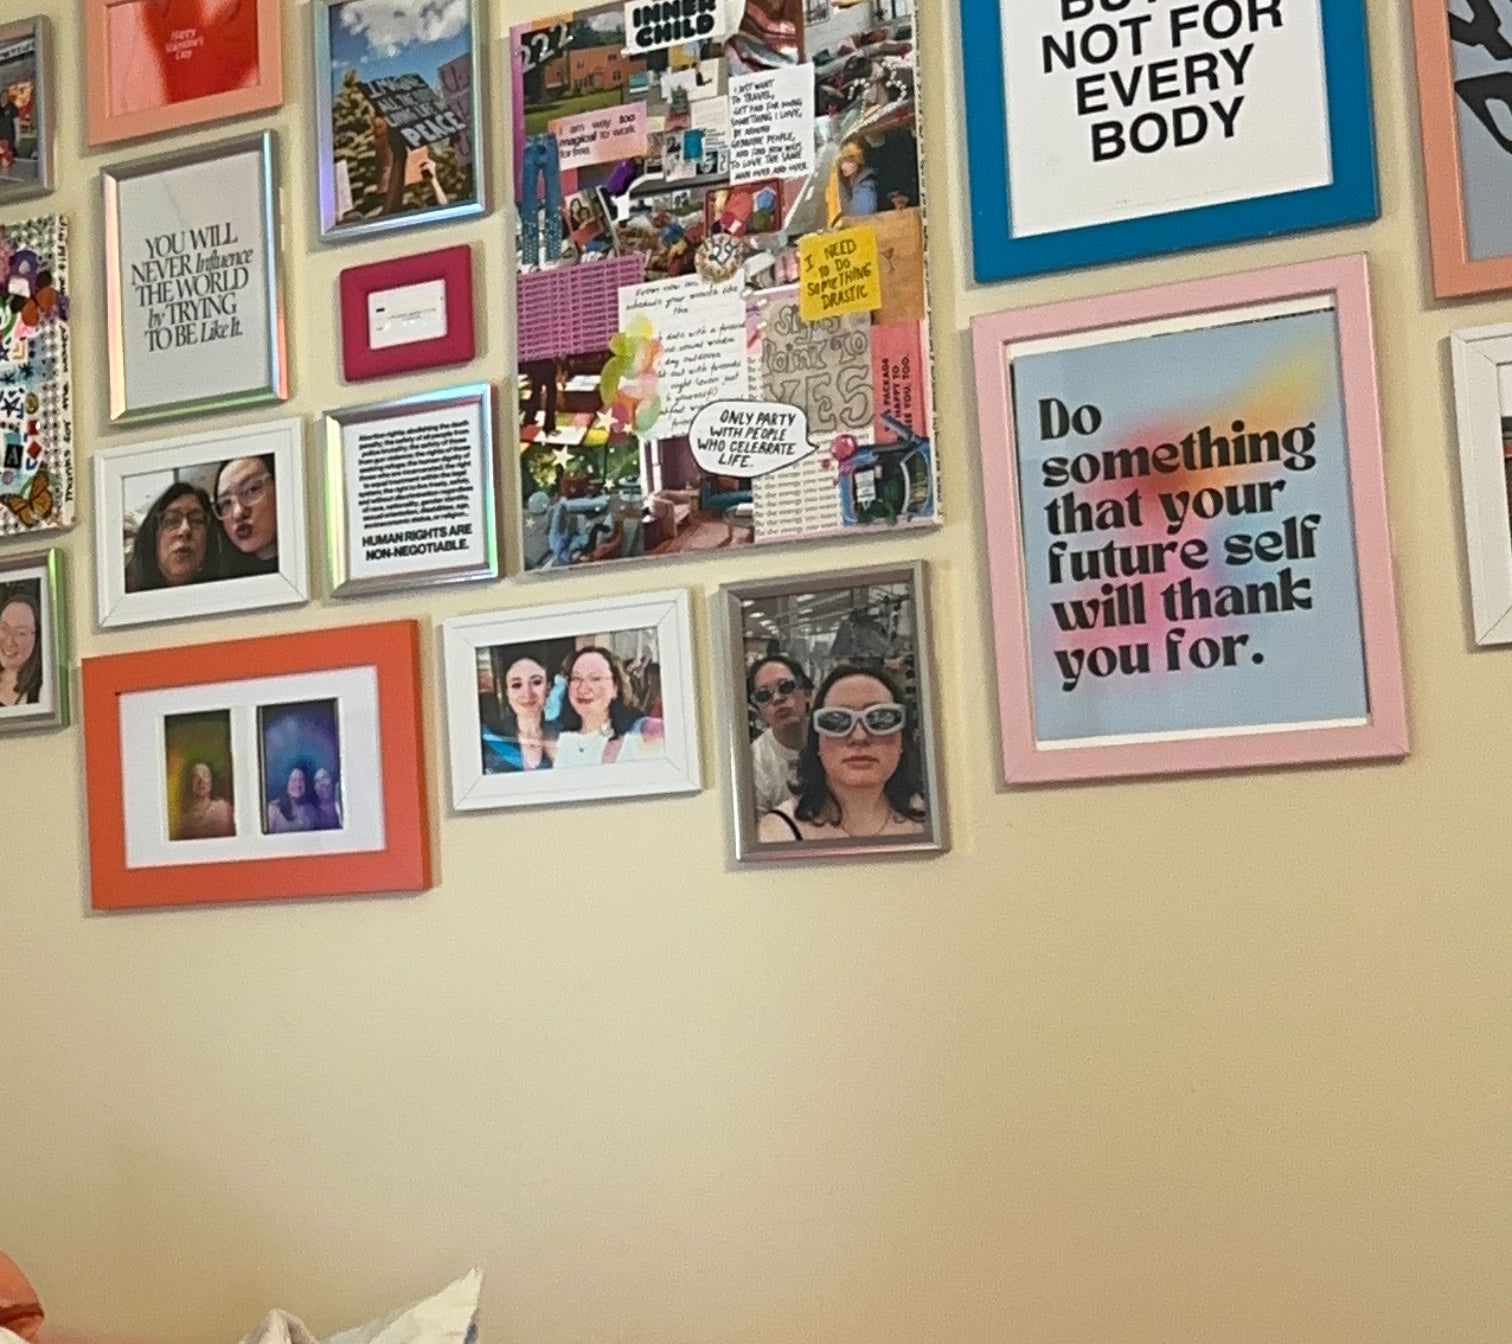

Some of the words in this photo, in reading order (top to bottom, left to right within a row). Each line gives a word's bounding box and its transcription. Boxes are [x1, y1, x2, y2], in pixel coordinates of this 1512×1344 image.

[635, 13, 715, 48] CHILD
[1041, 14, 1153, 75] NOT
[1074, 43, 1256, 117] EVERY
[400, 111, 467, 148] PEACE
[1090, 95, 1246, 163] BODY
[145, 230, 186, 259] YOU
[189, 222, 238, 250] WILL
[804, 254, 814, 273] I
[824, 239, 857, 260] NEED
[131, 254, 192, 286] NEVER
[135, 280, 174, 307] THE
[176, 266, 249, 299] WORLD
[807, 262, 872, 296] SOMETHING
[819, 266, 830, 278] TO
[835, 258, 850, 271] DO
[148, 308, 165, 329] by
[165, 292, 237, 326] TRYING
[821, 284, 869, 310] DRASTIC
[144, 327, 173, 352] TO
[175, 322, 198, 347] BE
[200, 319, 229, 343] Like
[720, 409, 753, 425] ONLY
[755, 413, 797, 426] PARTY
[762, 364, 876, 434] YES
[710, 426, 743, 437] WITH
[745, 427, 786, 441] PEOPLE
[1037, 396, 1102, 441] Do
[697, 438, 725, 451] WHO
[730, 440, 797, 455] CELEBRATE
[1041, 419, 1317, 488] something
[1043, 488, 1143, 536] that
[1157, 479, 1286, 534] your
[362, 532, 404, 547] HUMAN
[405, 526, 448, 542] RIGHTS
[449, 523, 473, 537] ARE
[1046, 535, 1209, 585] future
[1222, 514, 1322, 567] self
[1049, 580, 1146, 633] will
[1160, 568, 1313, 622] thank
[1053, 641, 1151, 692] you
[1164, 627, 1265, 674] for.
